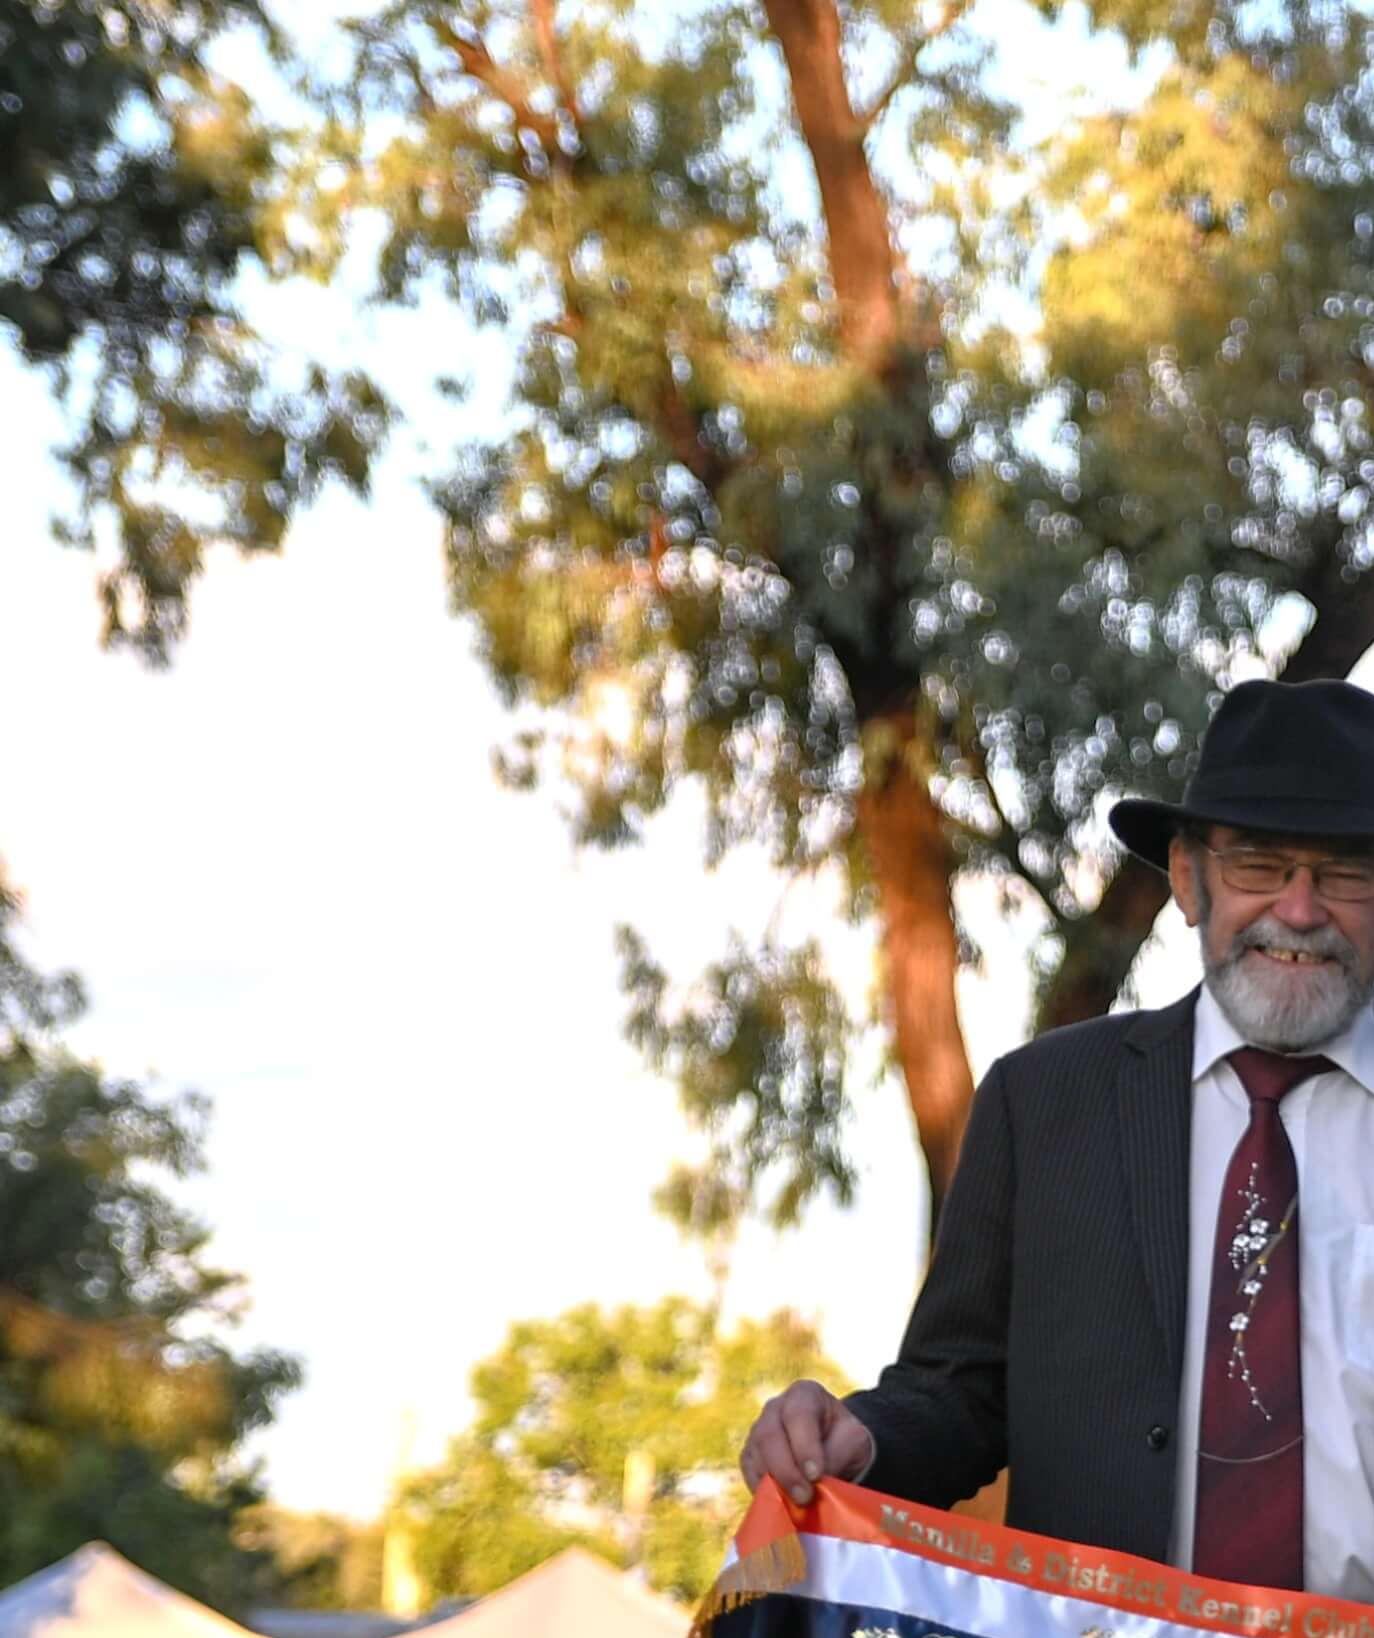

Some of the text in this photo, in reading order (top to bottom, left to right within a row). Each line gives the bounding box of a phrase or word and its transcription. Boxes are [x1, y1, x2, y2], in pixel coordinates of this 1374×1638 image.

[880, 1504, 996, 1567] Manilla
[1007, 1542, 1032, 1575] &
[1042, 1551, 1169, 1607] District
[1178, 1582, 1294, 1634] Kennel
